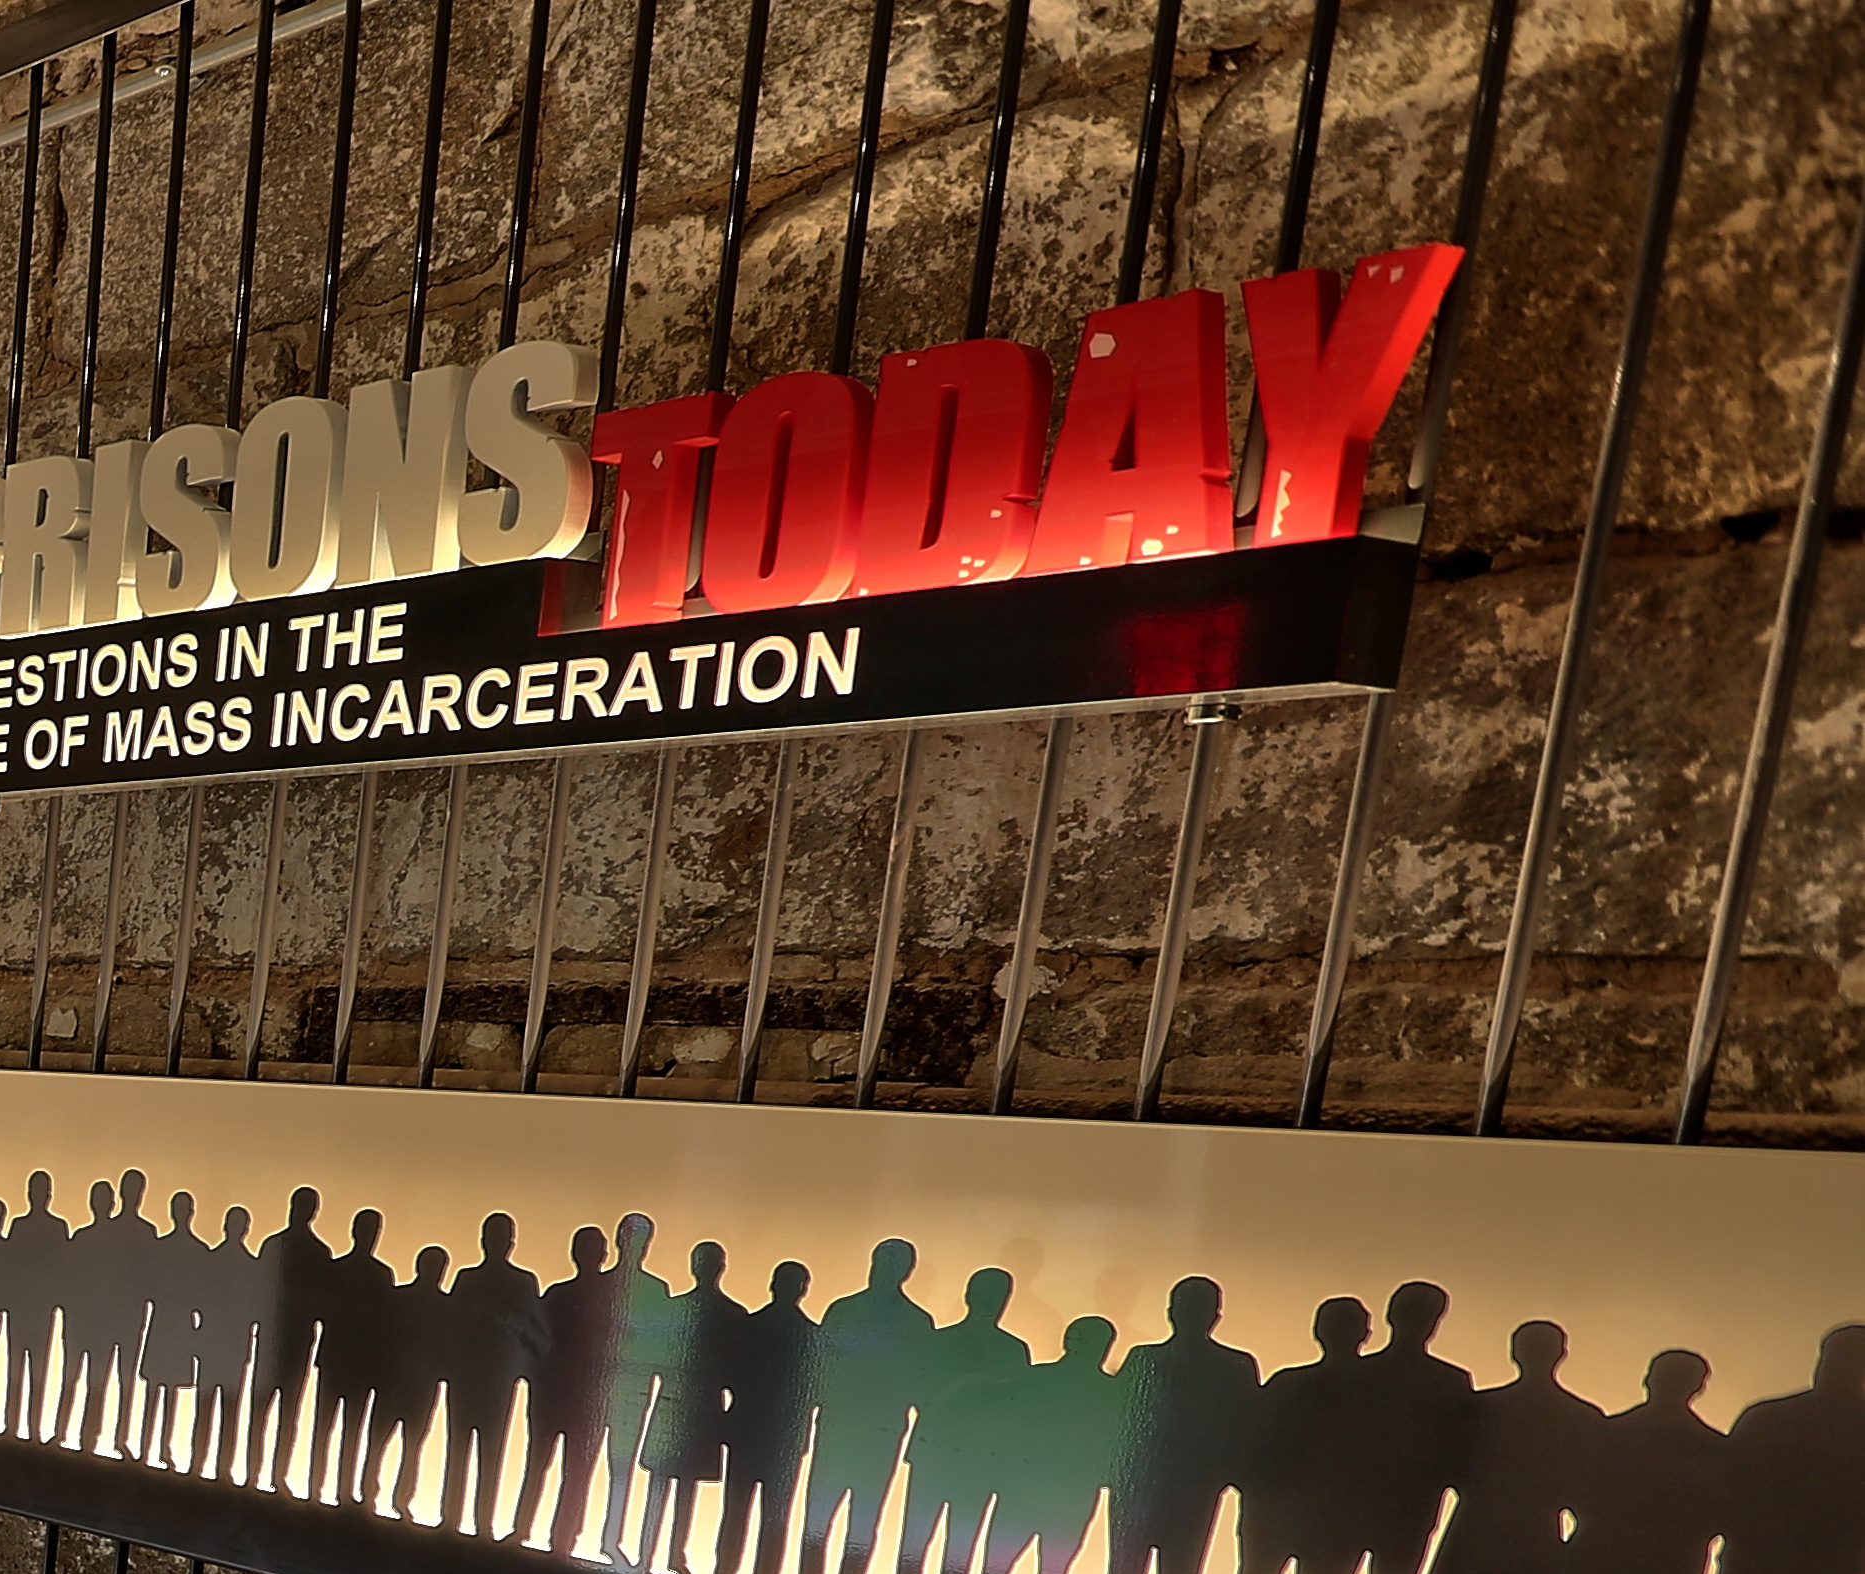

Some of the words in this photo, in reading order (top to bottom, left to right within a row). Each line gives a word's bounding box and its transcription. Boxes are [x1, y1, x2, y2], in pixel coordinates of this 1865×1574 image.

[591, 241, 1467, 630] TODAY
[24, 715, 89, 769] OF
[103, 697, 252, 763] MASS
[270, 628, 859, 747] INCARCERATION
[216, 622, 269, 681] IN
[289, 603, 407, 672] THE
